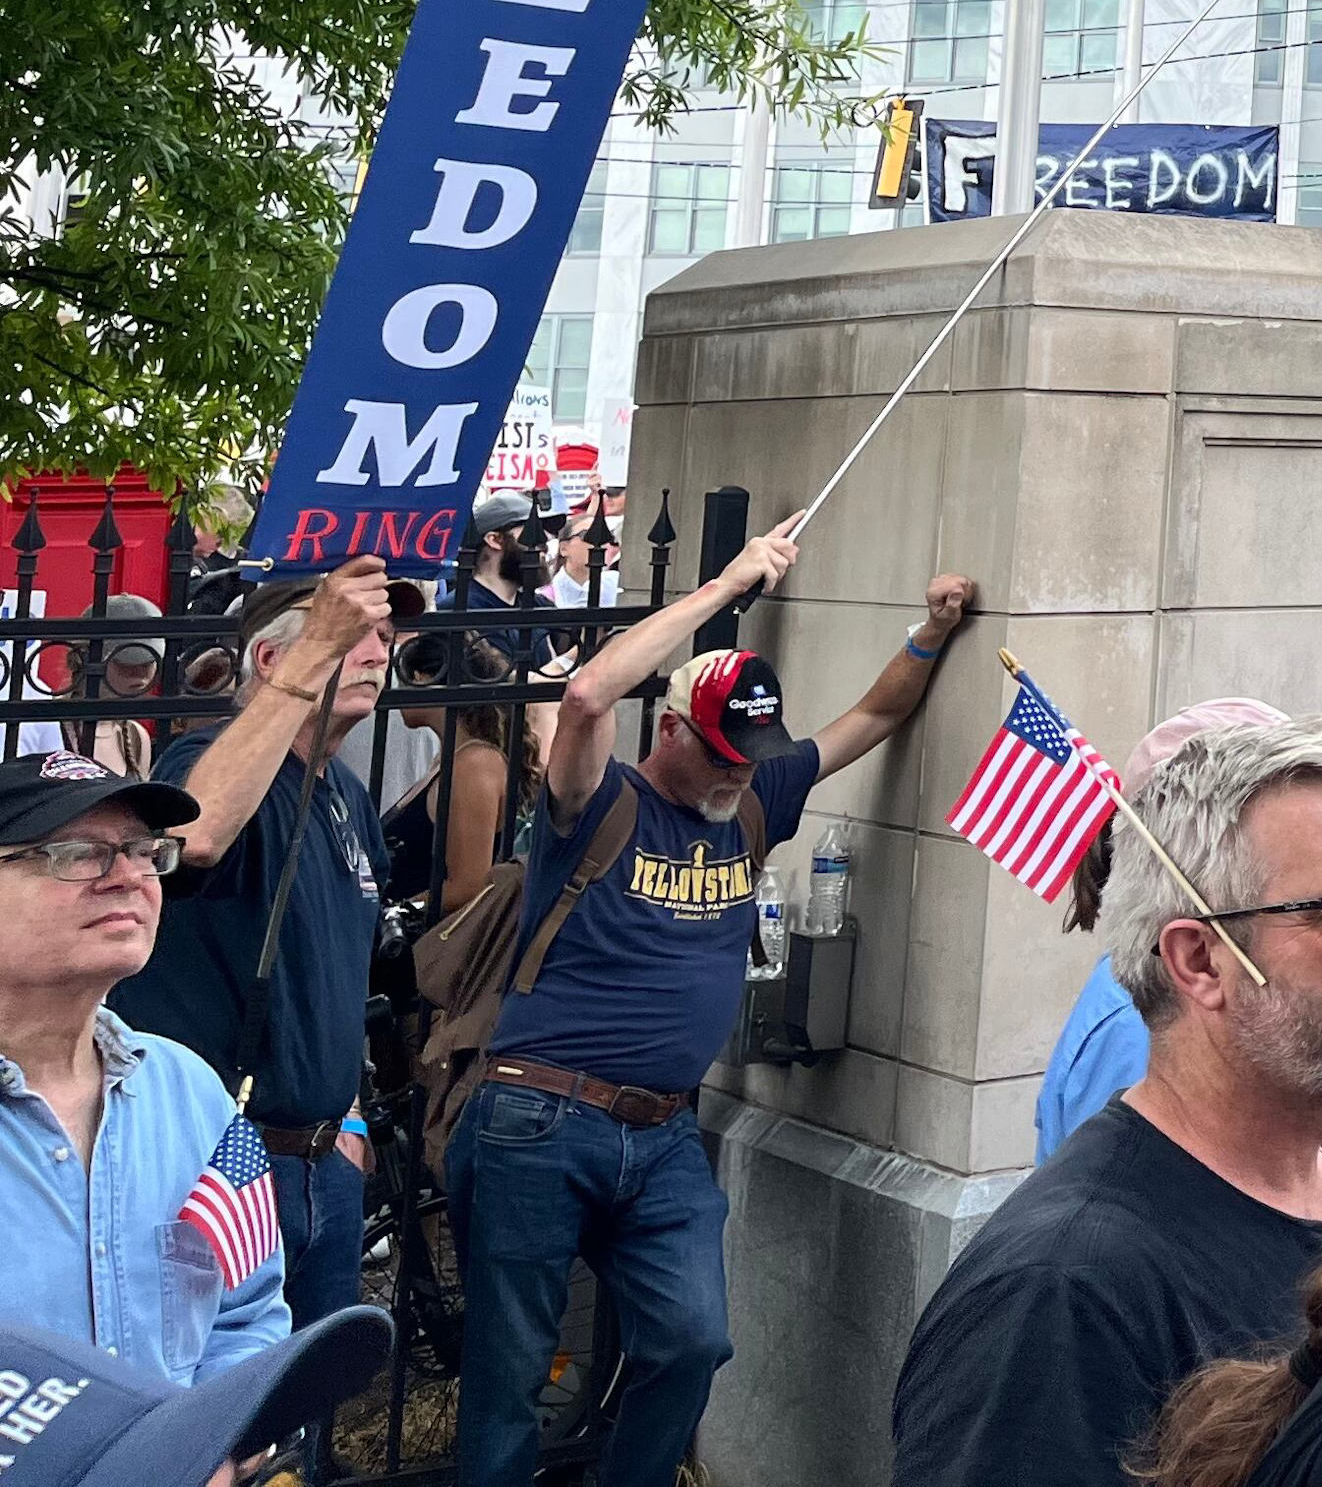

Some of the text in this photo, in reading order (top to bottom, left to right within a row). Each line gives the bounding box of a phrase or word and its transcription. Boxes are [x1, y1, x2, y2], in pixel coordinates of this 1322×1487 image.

[943, 135, 1276, 213] FREEDOM
[283, 508, 457, 562] RING
[630, 854, 754, 903] YELLOWSTN
[0, 1376, 91, 1445] HER.
